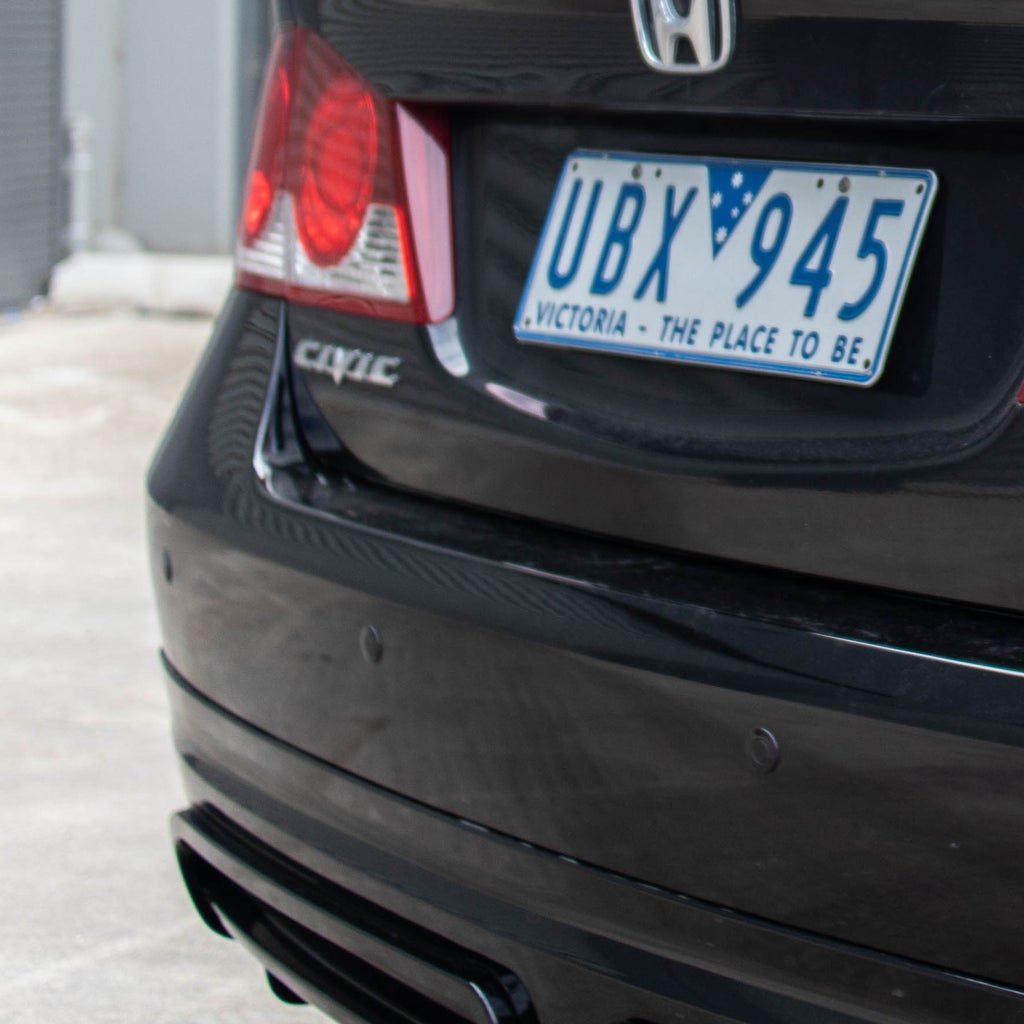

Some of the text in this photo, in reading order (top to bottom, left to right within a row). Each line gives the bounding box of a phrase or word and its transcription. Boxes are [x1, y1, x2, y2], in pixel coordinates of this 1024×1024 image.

[546, 177, 906, 321] UBX 945
[536, 300, 628, 338] VICTORIA
[659, 314, 702, 347] THE
[709, 321, 780, 356] PLACE
[789, 330, 820, 361] TO
[830, 335, 864, 366] BE
